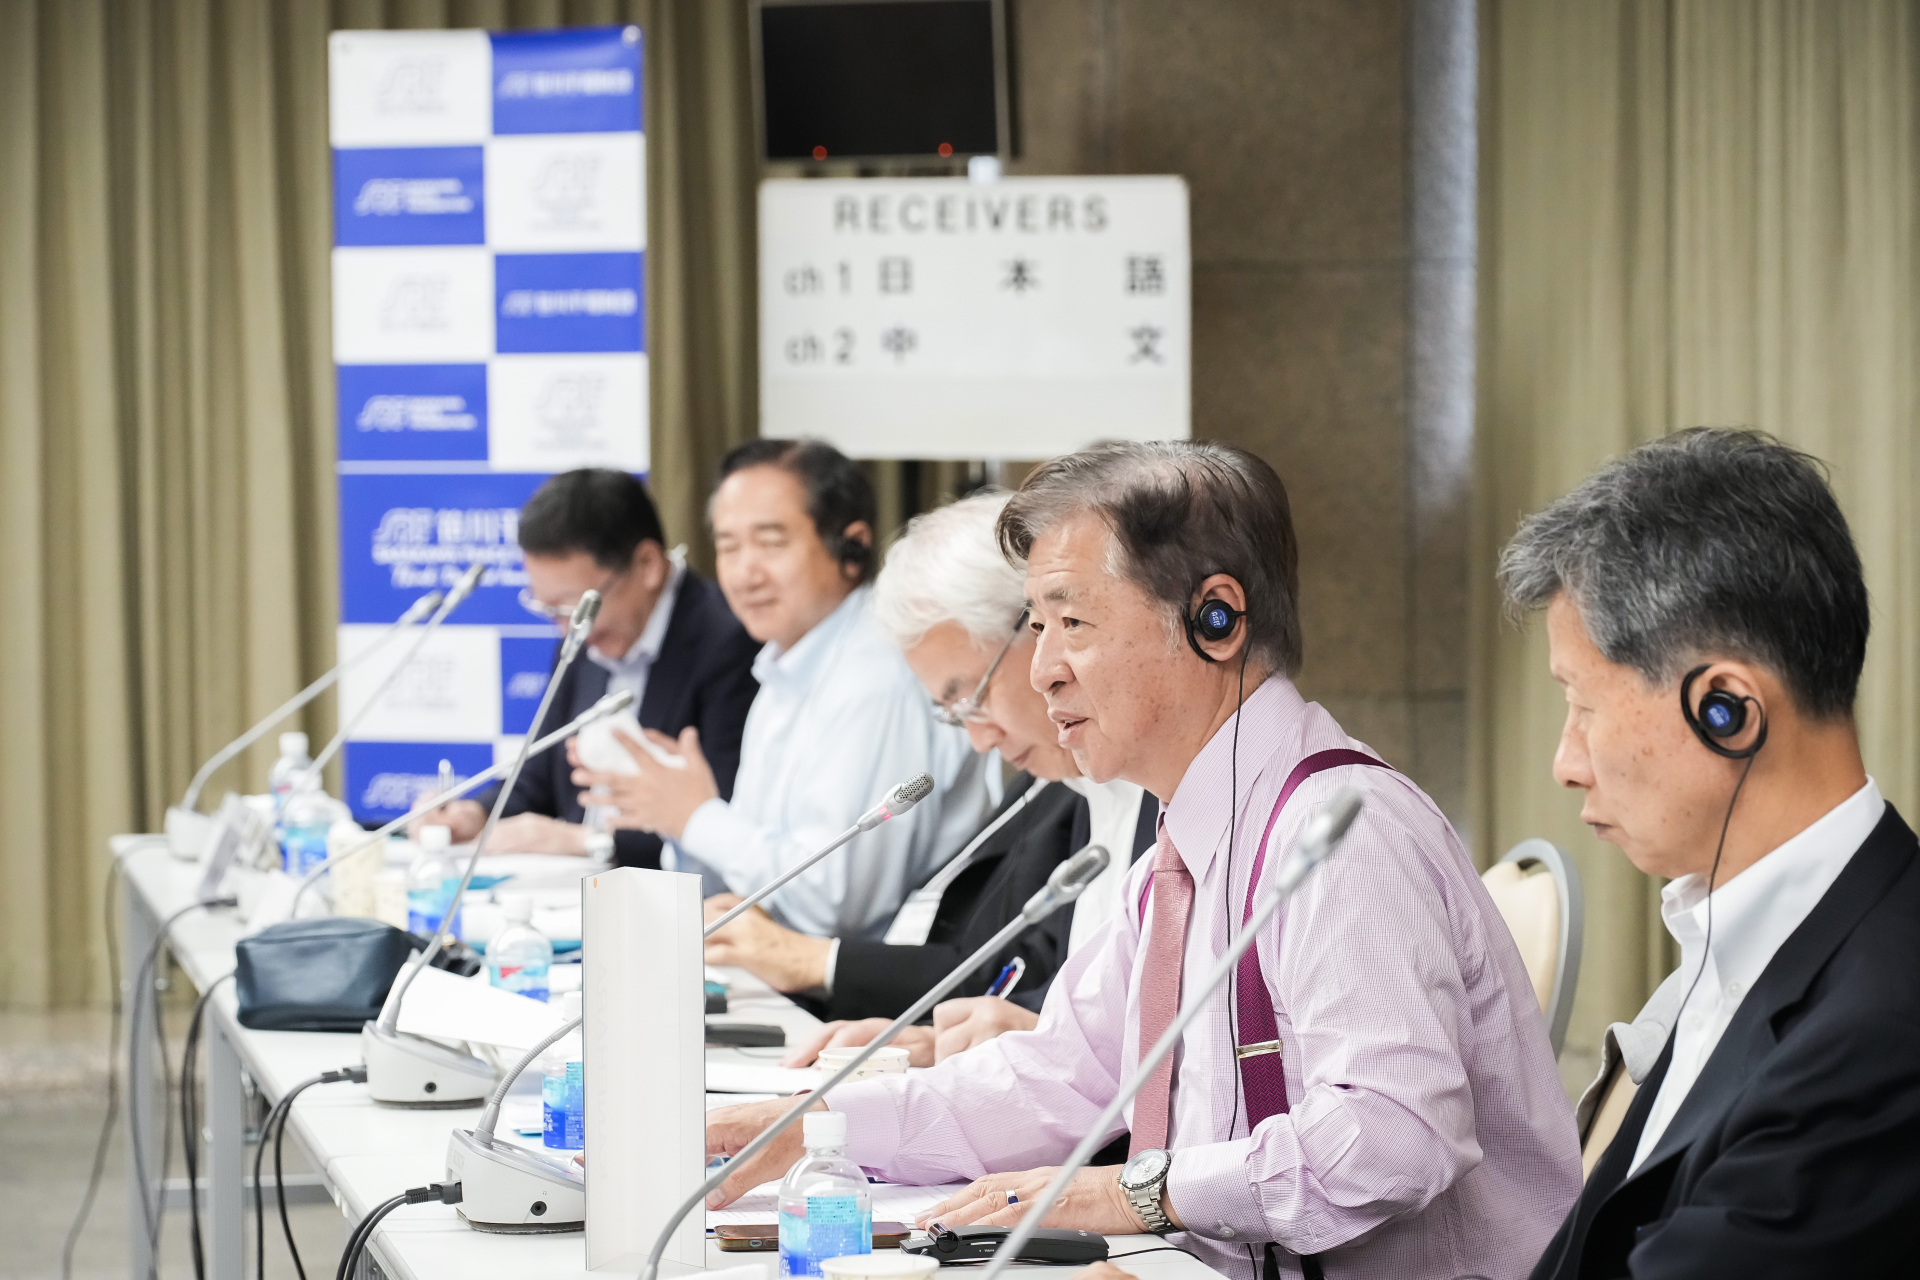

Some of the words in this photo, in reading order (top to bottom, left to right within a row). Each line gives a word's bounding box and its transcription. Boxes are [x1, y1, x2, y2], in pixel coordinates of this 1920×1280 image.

[833, 195, 1109, 232] RECEIVERS
[784, 264, 823, 296] ch
[837, 262, 852, 294] 1
[878, 256, 913, 294] 日
[784, 332, 824, 364] ch
[833, 330, 855, 364] 2
[881, 323, 917, 365] 中
[1127, 323, 1165, 365] 文
